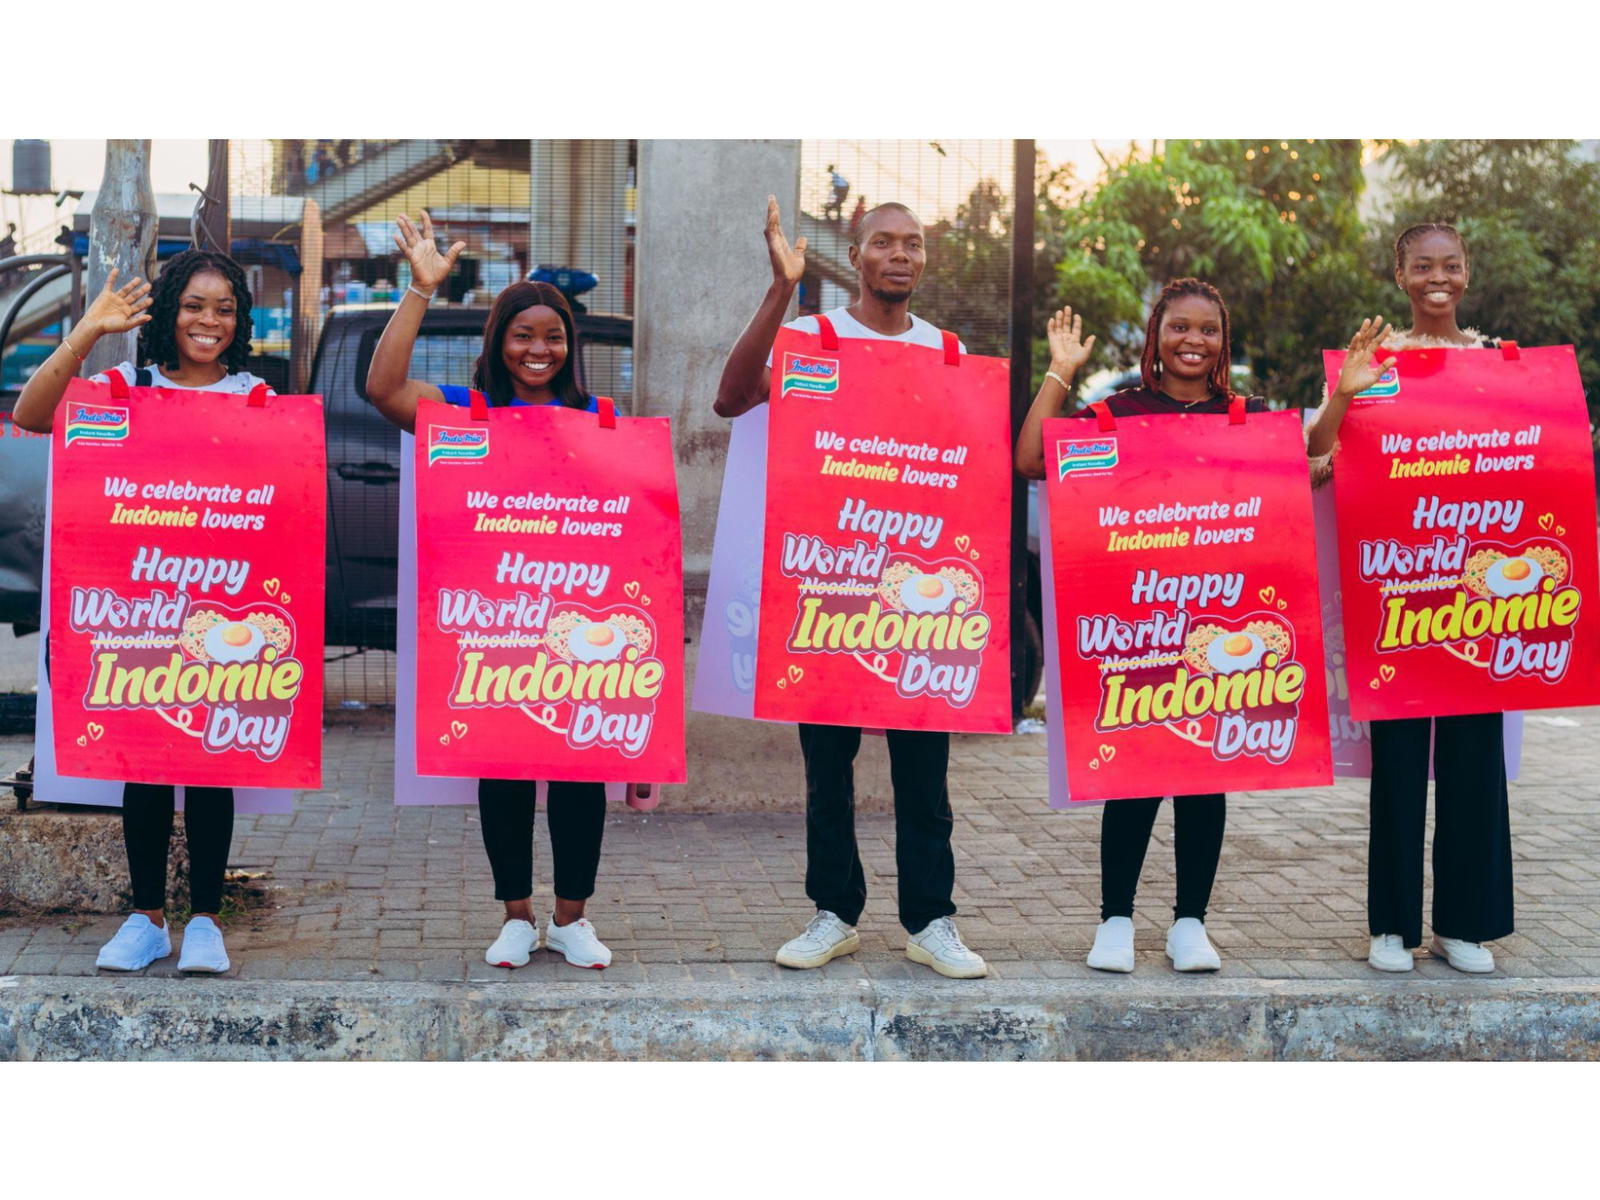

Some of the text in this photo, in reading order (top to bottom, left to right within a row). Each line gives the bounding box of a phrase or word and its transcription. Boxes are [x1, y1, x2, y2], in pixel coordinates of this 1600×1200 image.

[814, 430, 967, 465] We celebrate all
[1381, 425, 1541, 453] We celebrate all
[821, 454, 957, 489] Indomie lovers
[1389, 452, 1534, 479] Indomie lovers
[104, 477, 274, 504] We celebrate all
[466, 491, 630, 513] We celebrate all
[110, 503, 265, 531] Indomie lovers
[474, 513, 622, 537] Indomie lovers
[838, 498, 943, 549] Happy
[1099, 497, 1261, 527] We celebrate all
[1412, 496, 1524, 535] Happy
[785, 536, 886, 576] World
[1107, 526, 1254, 553] Indomie lovers
[1362, 536, 1465, 579] World
[131, 547, 250, 596] Happy
[496, 552, 610, 596] Happy
[803, 577, 873, 597] Noodles
[1131, 569, 1244, 609] Happy
[1384, 574, 1457, 597] Noodles
[74, 590, 187, 630] World
[441, 592, 548, 629] World
[793, 599, 989, 650] Indomie
[1380, 578, 1580, 650] Indomie
[96, 631, 174, 650] Noodles
[463, 632, 538, 648] Noodles
[1080, 612, 1187, 651] World
[89, 645, 301, 705] Indomie
[455, 647, 663, 703] Indomie
[1104, 649, 1177, 673] Noodles
[1493, 637, 1570, 680] Day
[903, 654, 977, 703] Day
[1100, 653, 1304, 727] Indomie
[209, 702, 287, 755] Day
[573, 704, 648, 752] Day
[1219, 714, 1295, 758] Day
